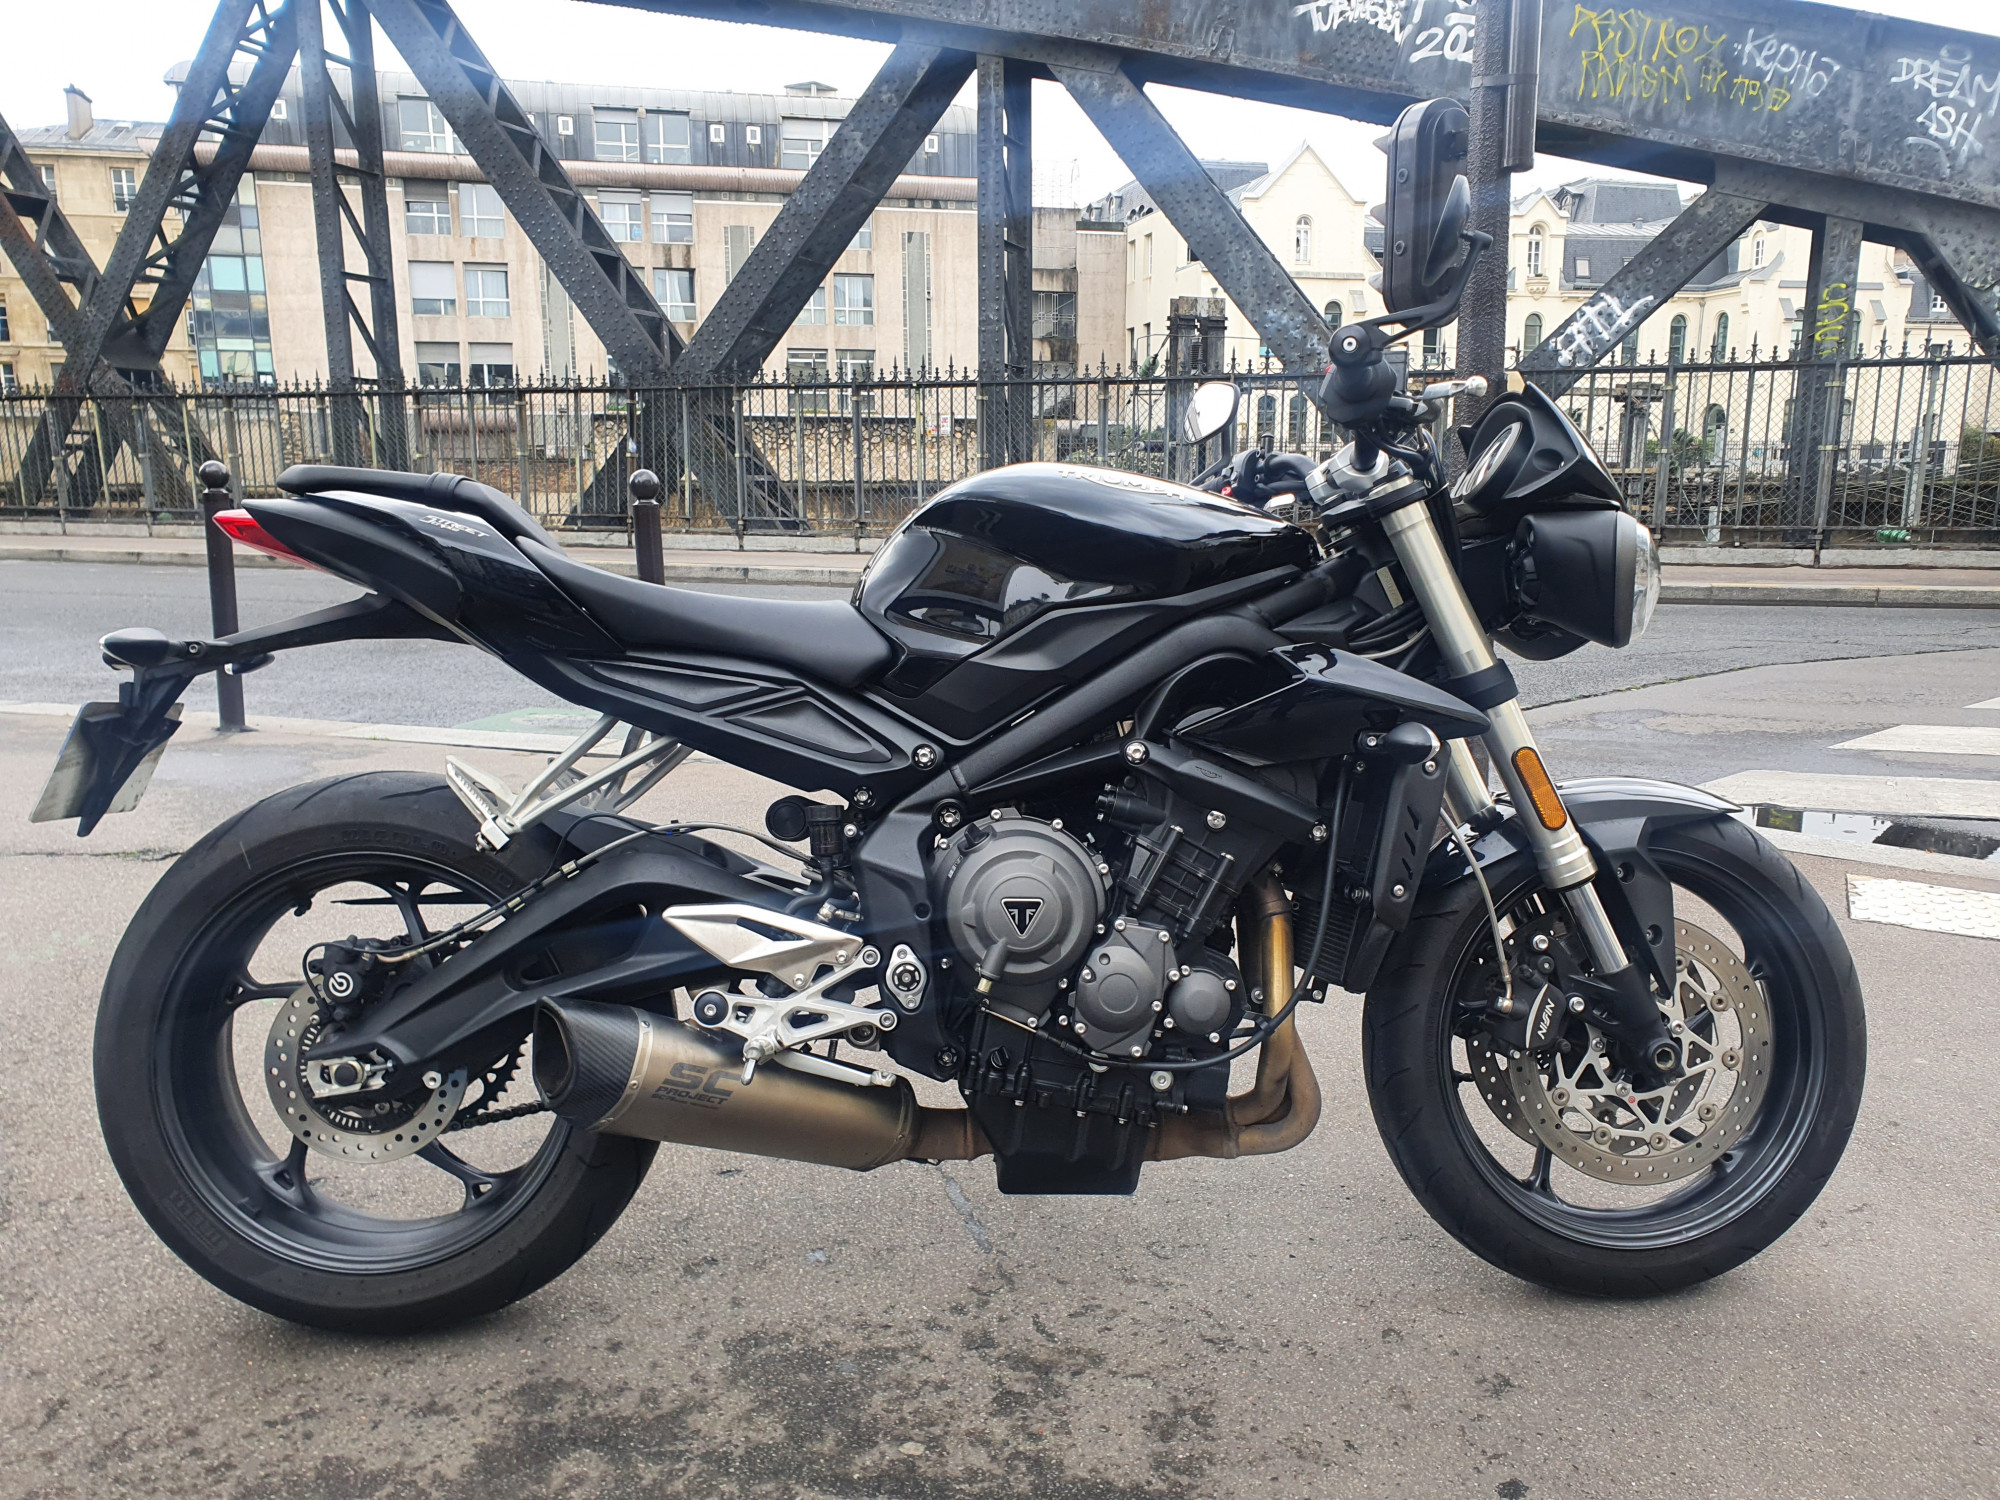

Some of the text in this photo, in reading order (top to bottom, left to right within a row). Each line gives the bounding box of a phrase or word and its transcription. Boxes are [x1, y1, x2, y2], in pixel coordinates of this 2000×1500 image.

[1569, 4, 1727, 63] DESTROY
[1890, 57, 2000, 117] DREAM
[1916, 101, 1984, 168] ASH
[1537, 998, 1555, 1040] NISSIN
[655, 1085, 729, 1105] PROJECT
[662, 1062, 742, 1097] SC
